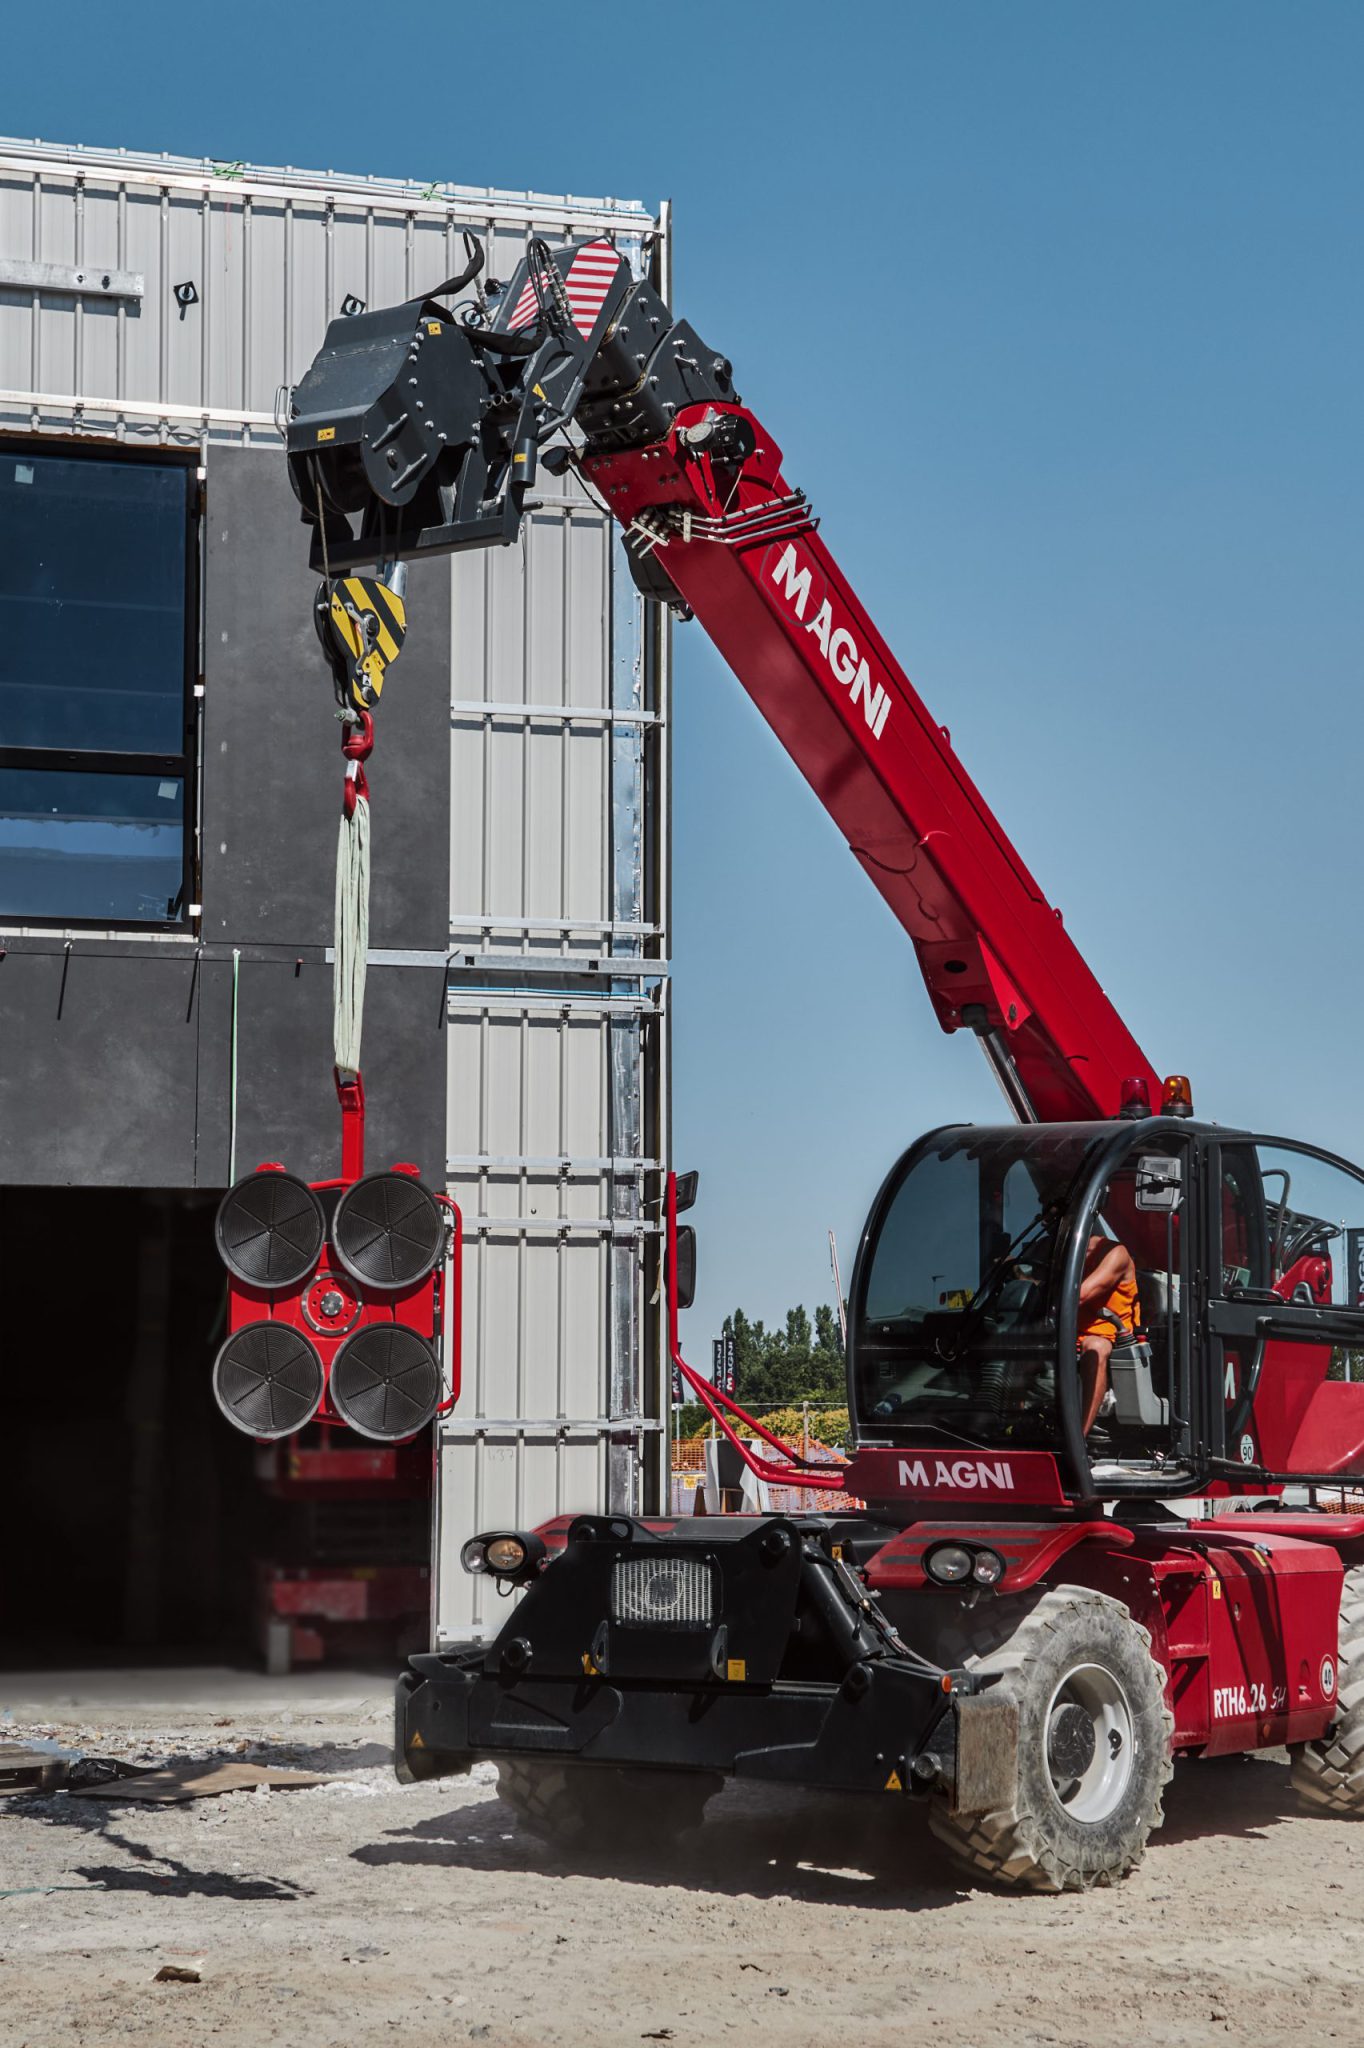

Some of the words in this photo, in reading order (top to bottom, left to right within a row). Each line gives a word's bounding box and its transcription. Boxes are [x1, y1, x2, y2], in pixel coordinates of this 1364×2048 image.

[771, 542, 893, 741] MAGNI
[726, 1341, 734, 1391] MAGNI
[1242, 1446, 1253, 1461] 90
[898, 1459, 1015, 1490] MAGNI
[1213, 1681, 1267, 1719] RTH6.26
[1270, 1686, 1287, 1710] SH
